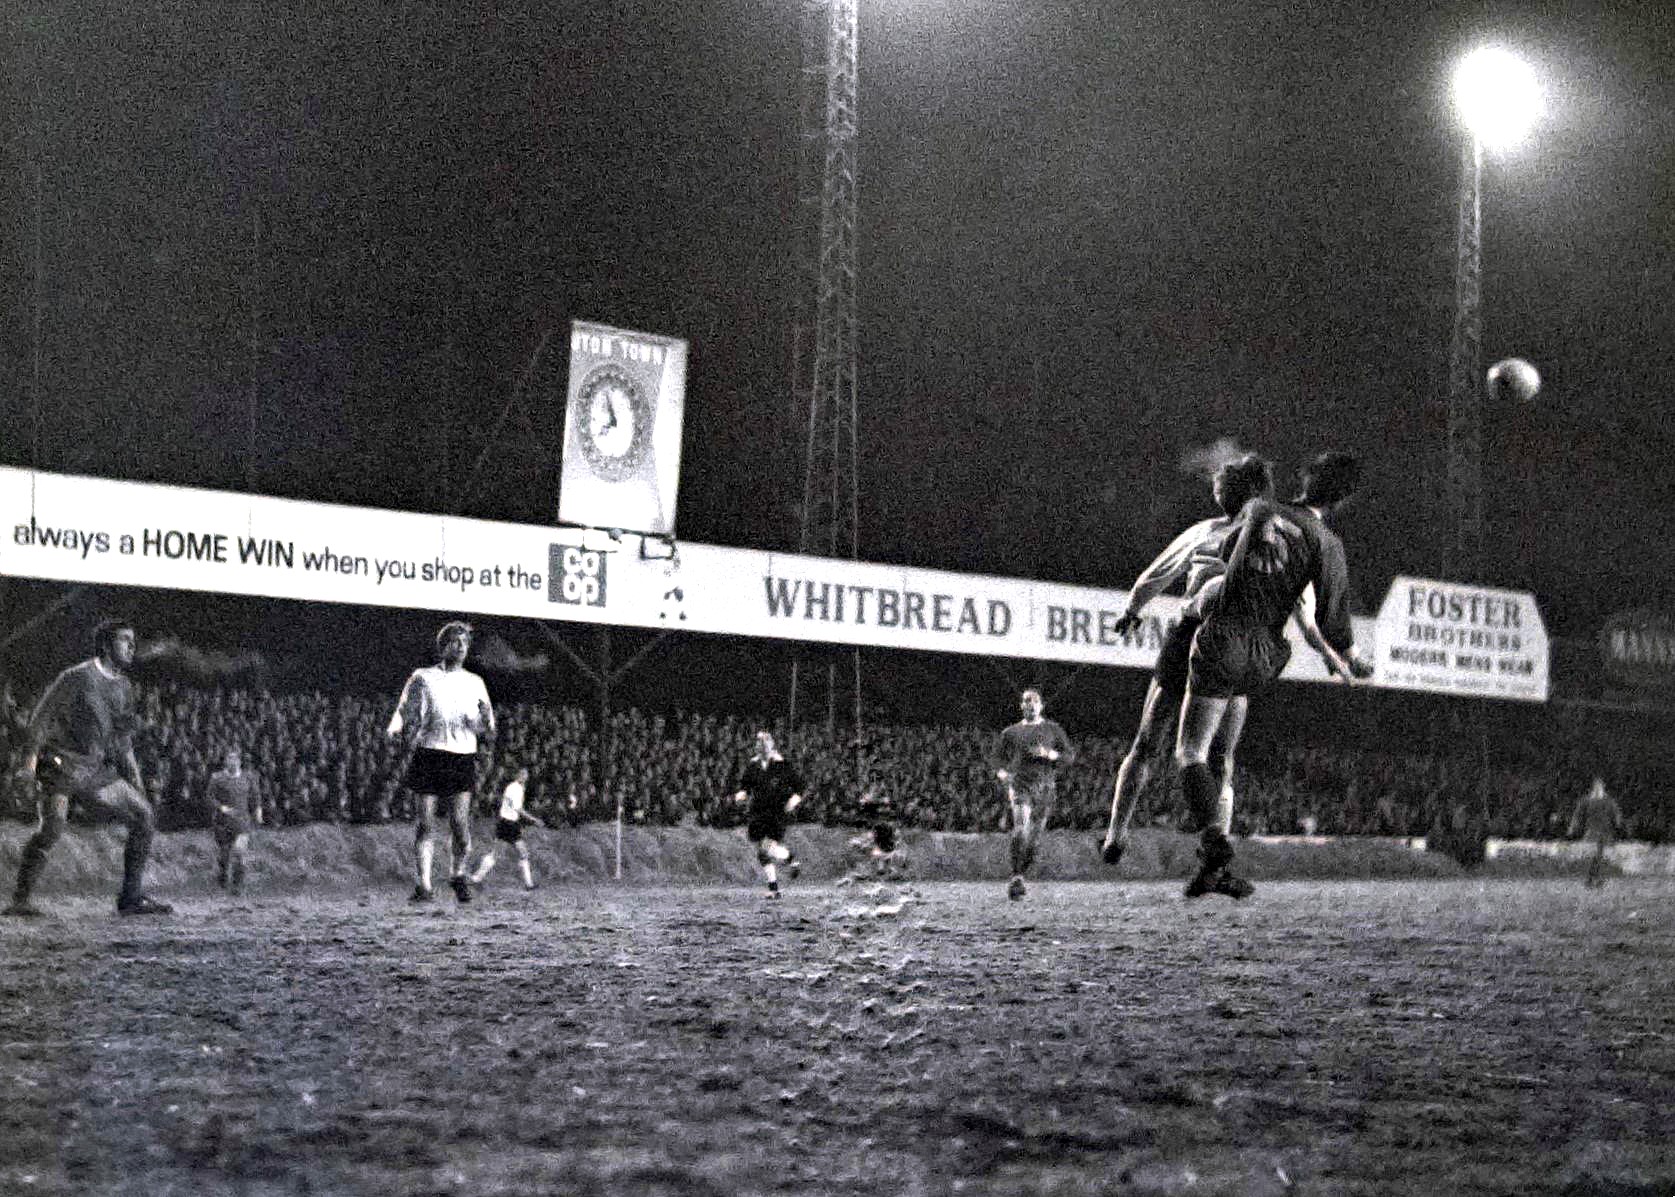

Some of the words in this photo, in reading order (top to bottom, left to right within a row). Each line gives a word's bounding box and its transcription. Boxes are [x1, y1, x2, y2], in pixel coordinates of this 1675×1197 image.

[14, 517, 110, 560] always
[119, 534, 135, 556] a
[143, 528, 228, 564] HOME
[237, 534, 295, 569] WIN
[302, 546, 369, 577] when
[376, 558, 416, 586] you
[421, 557, 474, 592] shop
[479, 567, 502, 587] at
[507, 565, 543, 591] the
[763, 577, 1013, 637] WHITBREAD
[1409, 586, 1521, 629] FOSTER
